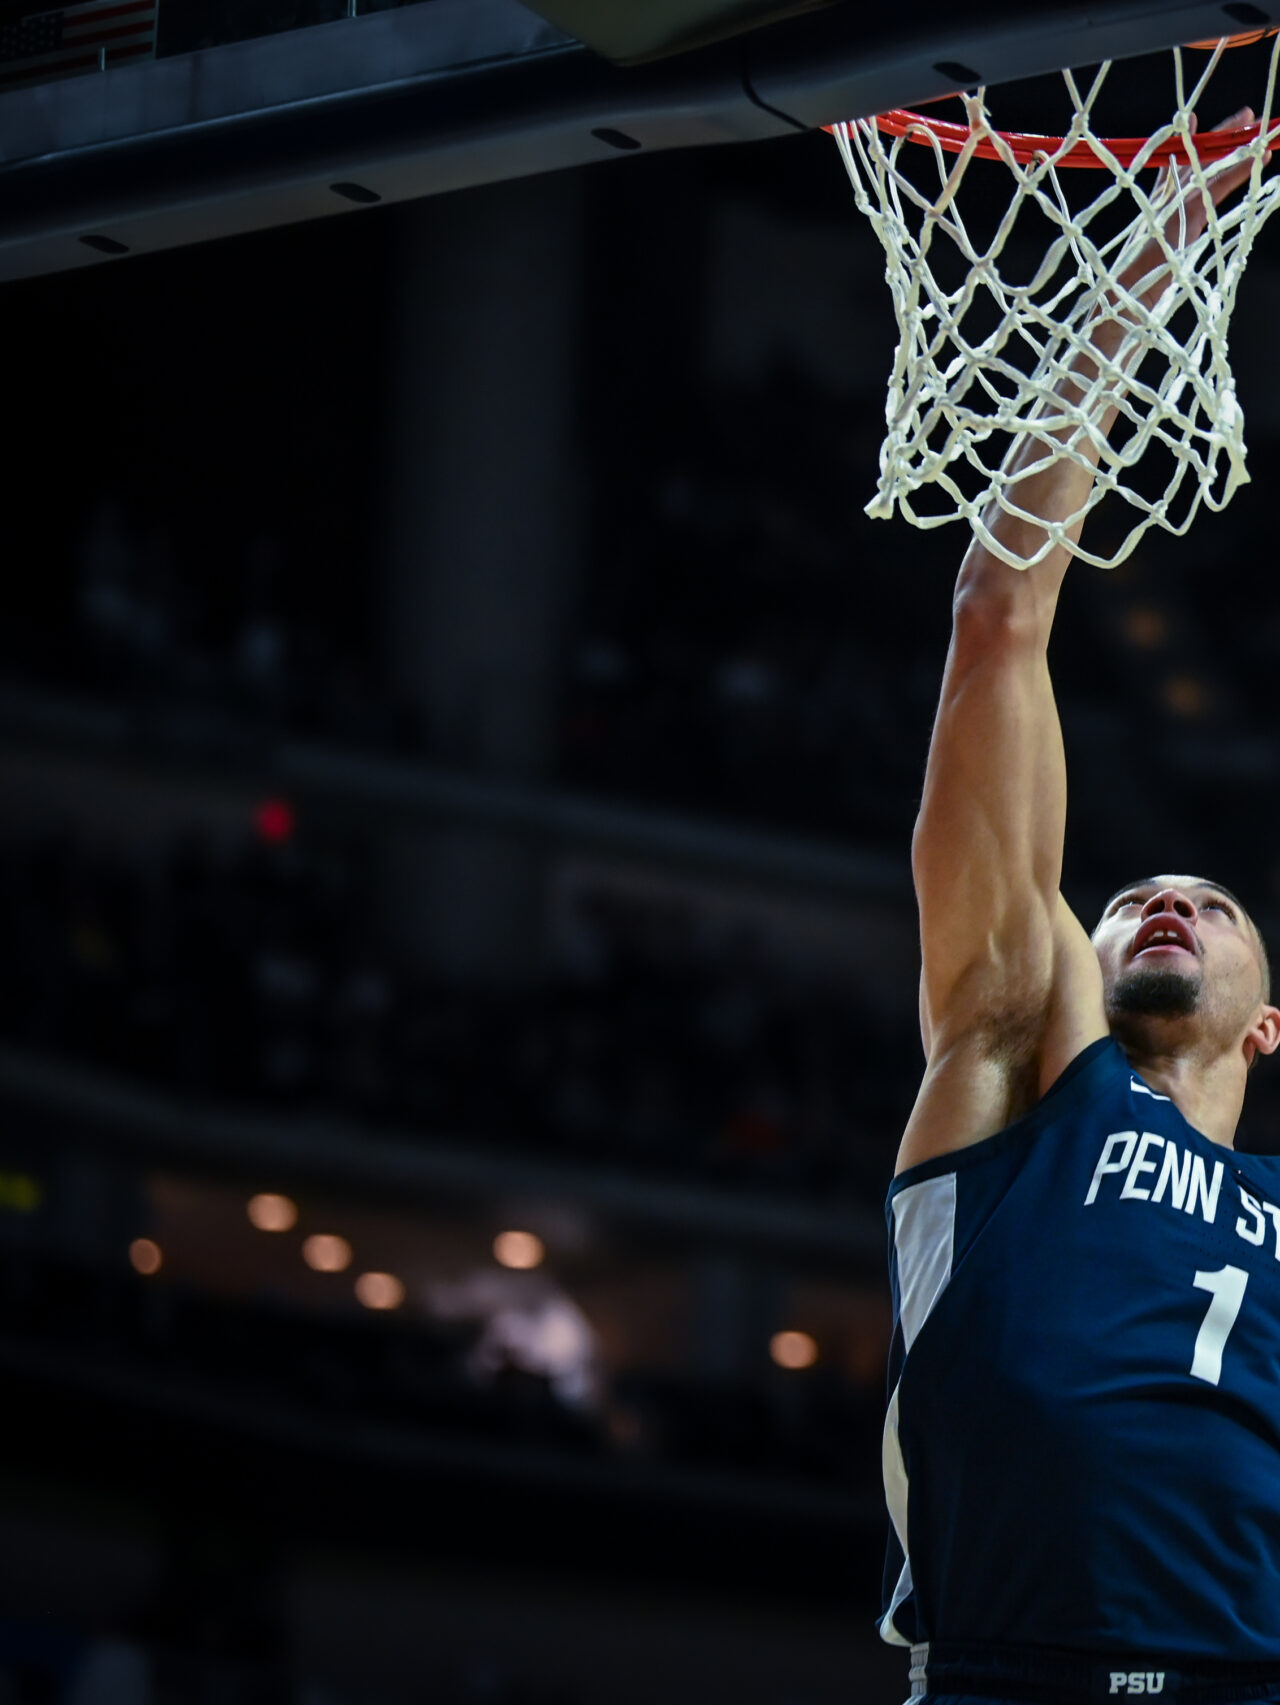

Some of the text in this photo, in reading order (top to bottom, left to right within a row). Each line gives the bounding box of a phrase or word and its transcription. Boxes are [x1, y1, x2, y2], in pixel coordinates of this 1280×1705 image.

[1084, 1131, 1225, 1224] PENN
[1190, 1264, 1249, 1386] 1
[1109, 1672, 1165, 1694] PSU
